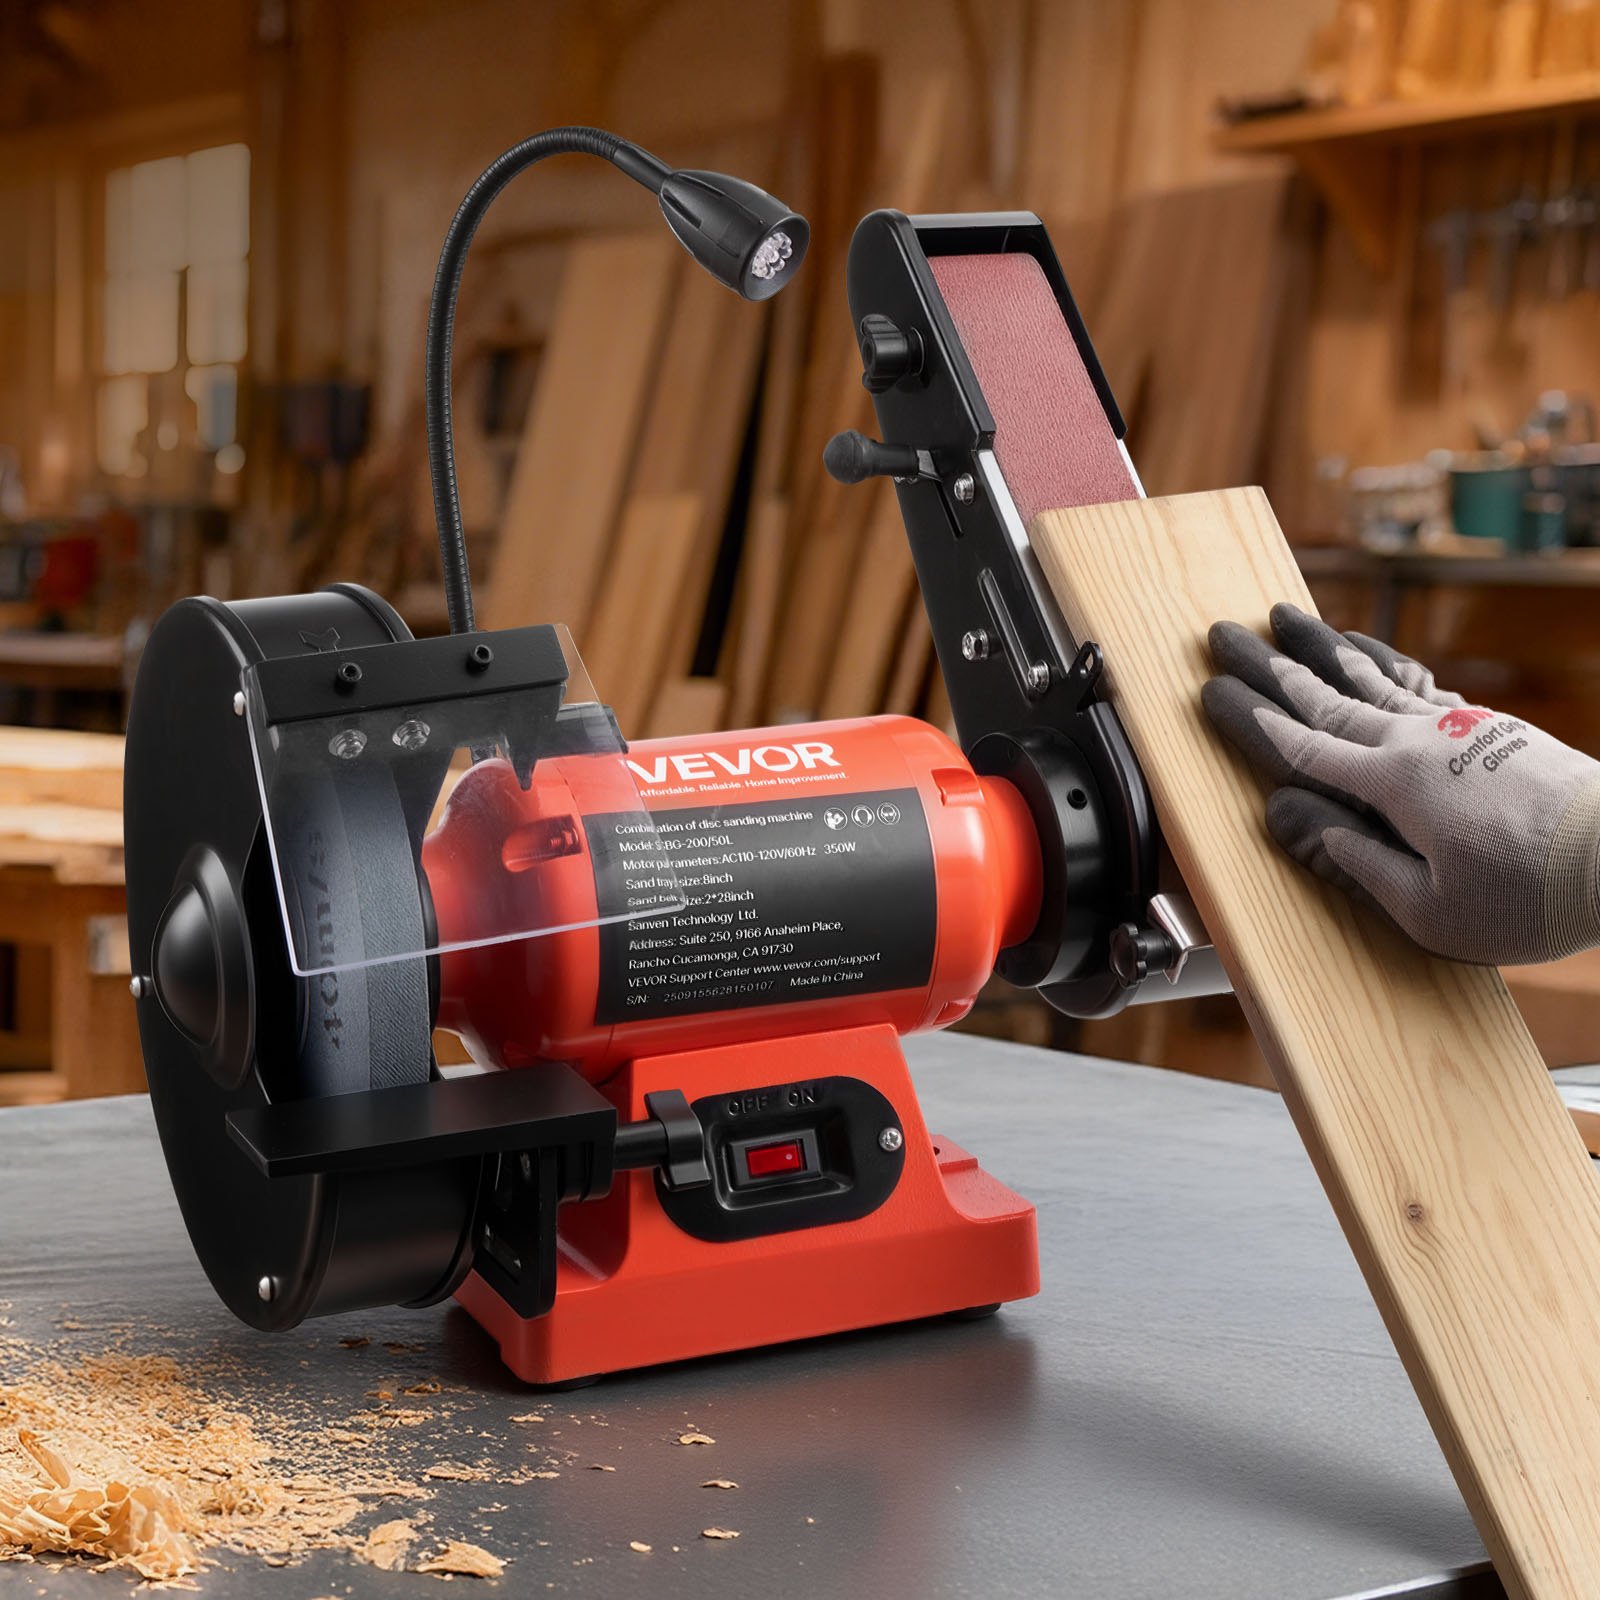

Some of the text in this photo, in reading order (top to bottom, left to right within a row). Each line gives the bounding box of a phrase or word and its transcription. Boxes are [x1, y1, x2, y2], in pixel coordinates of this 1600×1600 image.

[620, 742, 842, 784] VEVOR
[1449, 725, 1504, 776] Comfort
[1482, 737, 1528, 772] Gloves
[745, 778, 777, 788] Home
[777, 771, 850, 785] Improvement.
[685, 820, 696, 831] of
[698, 818, 721, 829] disc
[723, 815, 767, 827] sanding
[767, 811, 813, 823] machine
[622, 859, 655, 871] Motor
[823, 841, 856, 855] 350W
[625, 877, 655, 890] Sand
[678, 872, 733, 887] size:8inch
[627, 896, 657, 906] Sand
[628, 908, 758, 931] Sanven Technology Ltd.
[628, 920, 844, 951] Address: Suite 250, 9166 Anaheim Place,
[628, 943, 794, 970] Rancho Cucamonga, CA 91730
[628, 952, 881, 988] VEVOR Support Center www.vevor.com/support
[626, 994, 650, 1005] S/N:
[789, 975, 821, 987] Made
[833, 970, 864, 982] China
[728, 1087, 816, 1116] OFF ON
